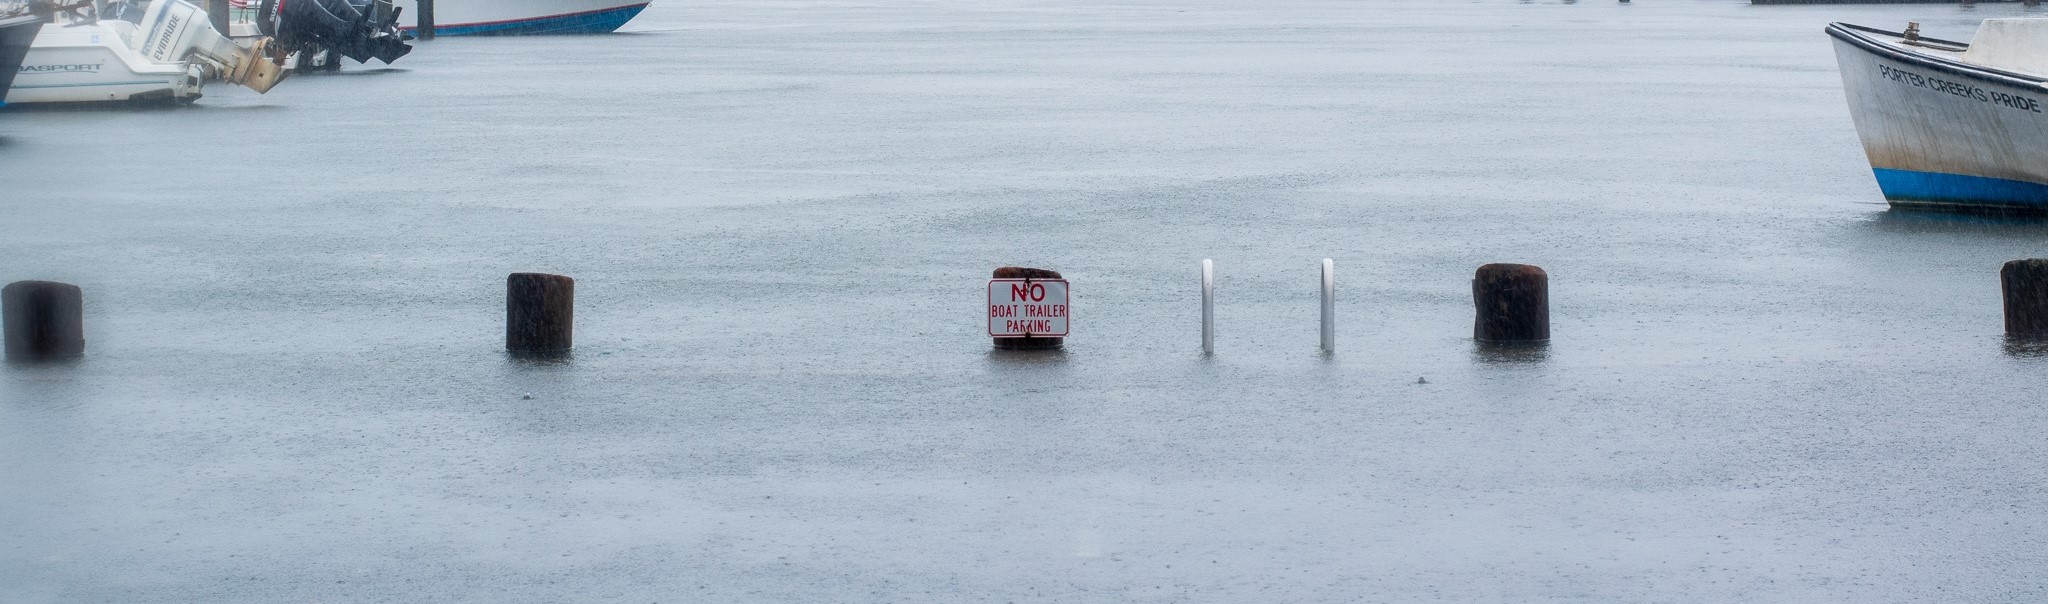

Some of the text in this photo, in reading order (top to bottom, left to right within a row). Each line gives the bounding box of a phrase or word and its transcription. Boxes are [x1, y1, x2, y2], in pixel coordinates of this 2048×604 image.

[154, 13, 181, 60] EVINRUDE
[1879, 64, 2042, 113] PORTER CREEK'S PRIDE
[1011, 283, 1045, 302] NO
[992, 305, 1065, 317] BOAT TRAILER
[1006, 320, 1051, 332] PARKING
